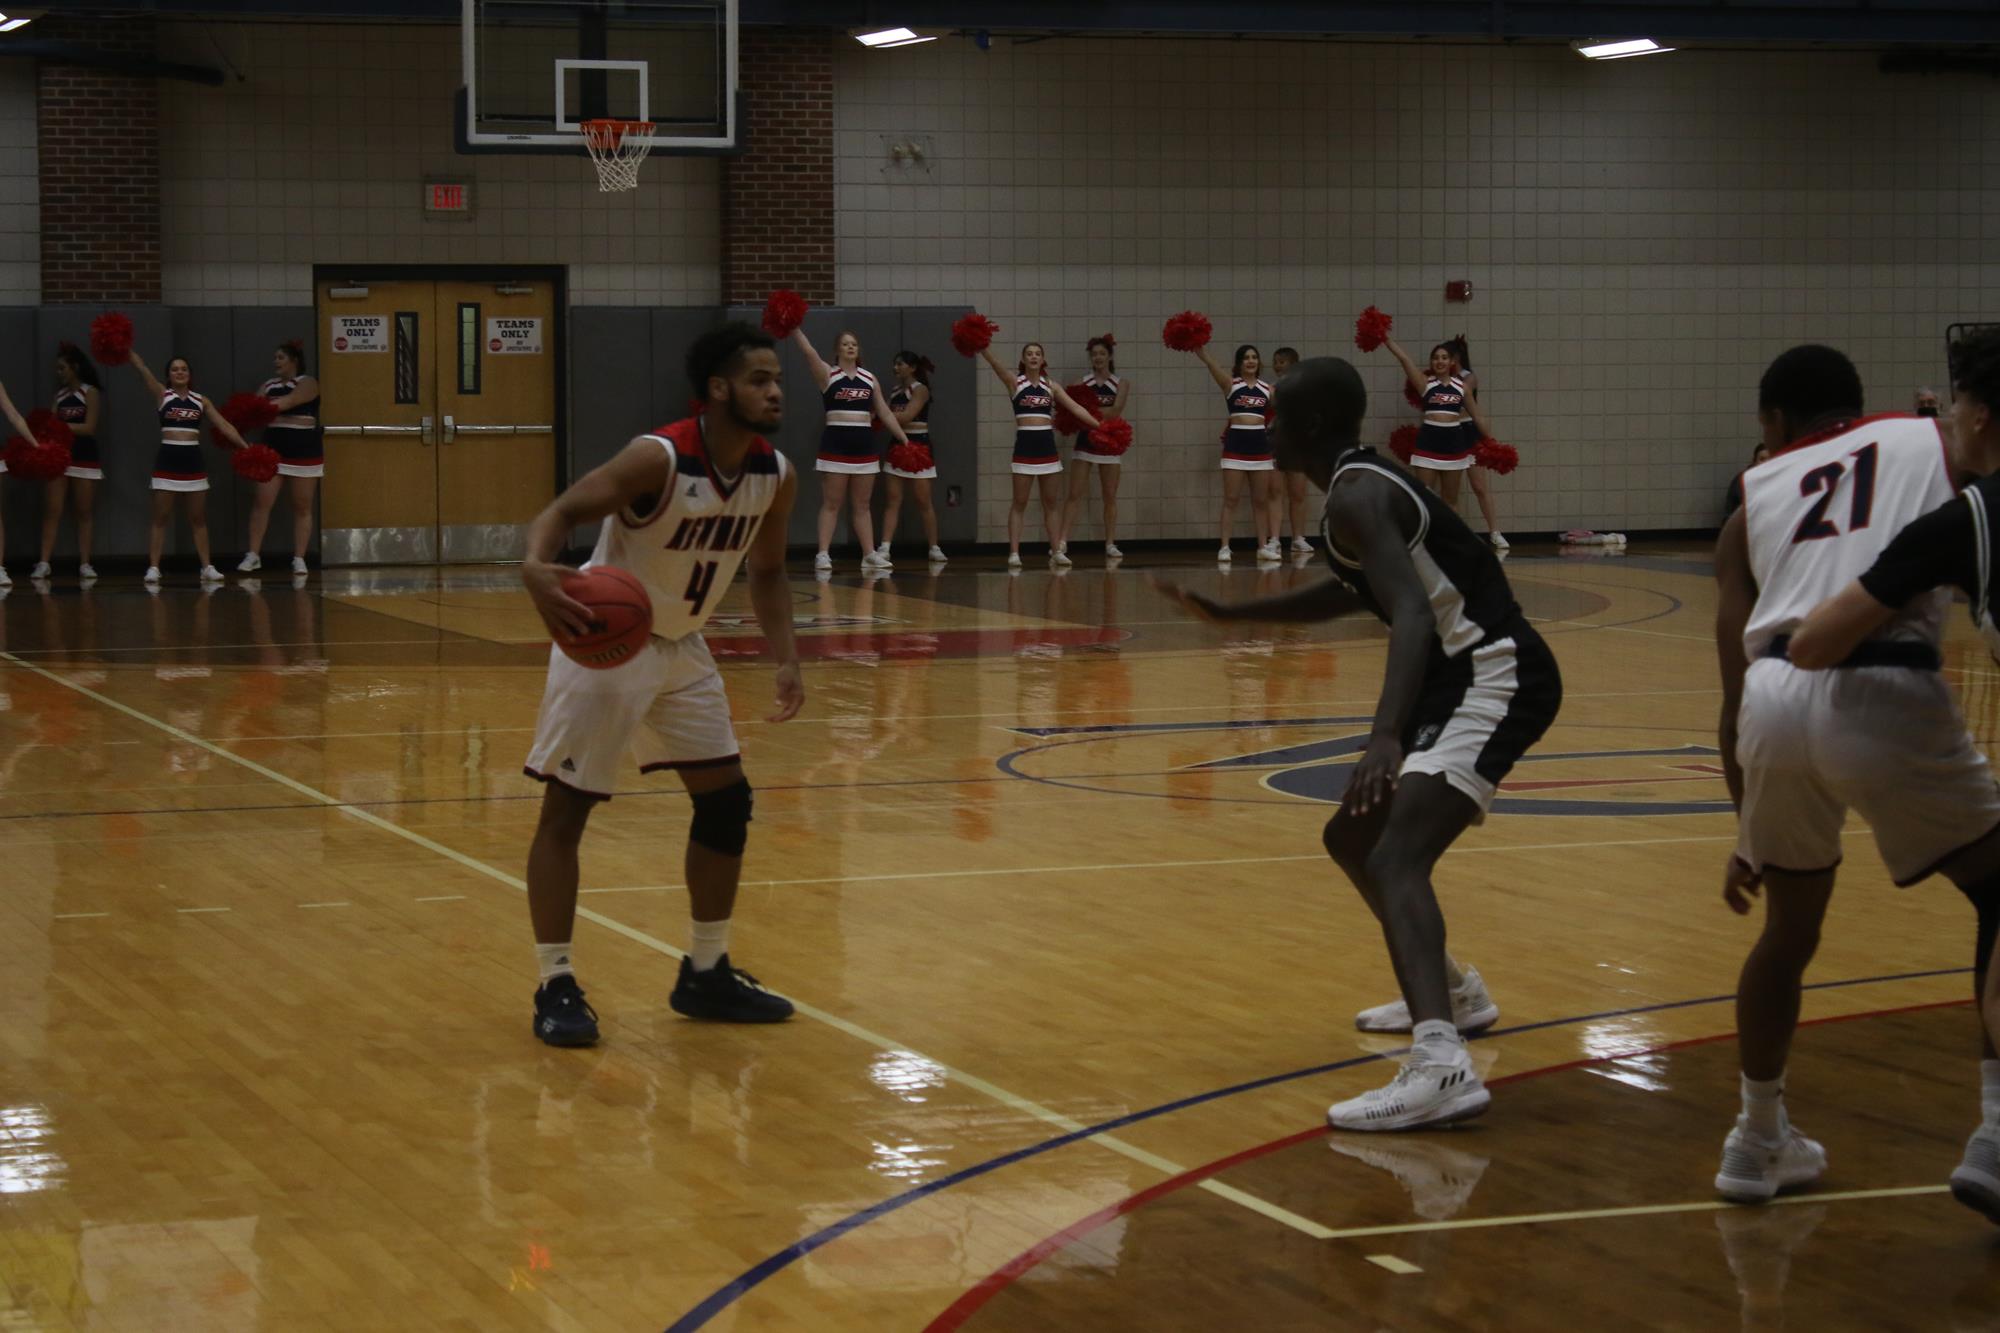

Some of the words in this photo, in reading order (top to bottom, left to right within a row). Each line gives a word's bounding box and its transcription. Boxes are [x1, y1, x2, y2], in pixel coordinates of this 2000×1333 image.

[434, 184, 462, 208] EXIT
[341, 318, 380, 327] TEAMS
[496, 320, 535, 328] TEAMS
[346, 328, 376, 337] ONLY
[501, 330, 529, 338] ONLY
[834, 387, 872, 401] JETS
[1428, 393, 1461, 406] JETS
[1234, 395, 1266, 408] JETS
[164, 407, 201, 421] JETS
[1791, 442, 1878, 543] 21
[684, 560, 719, 617] 4
